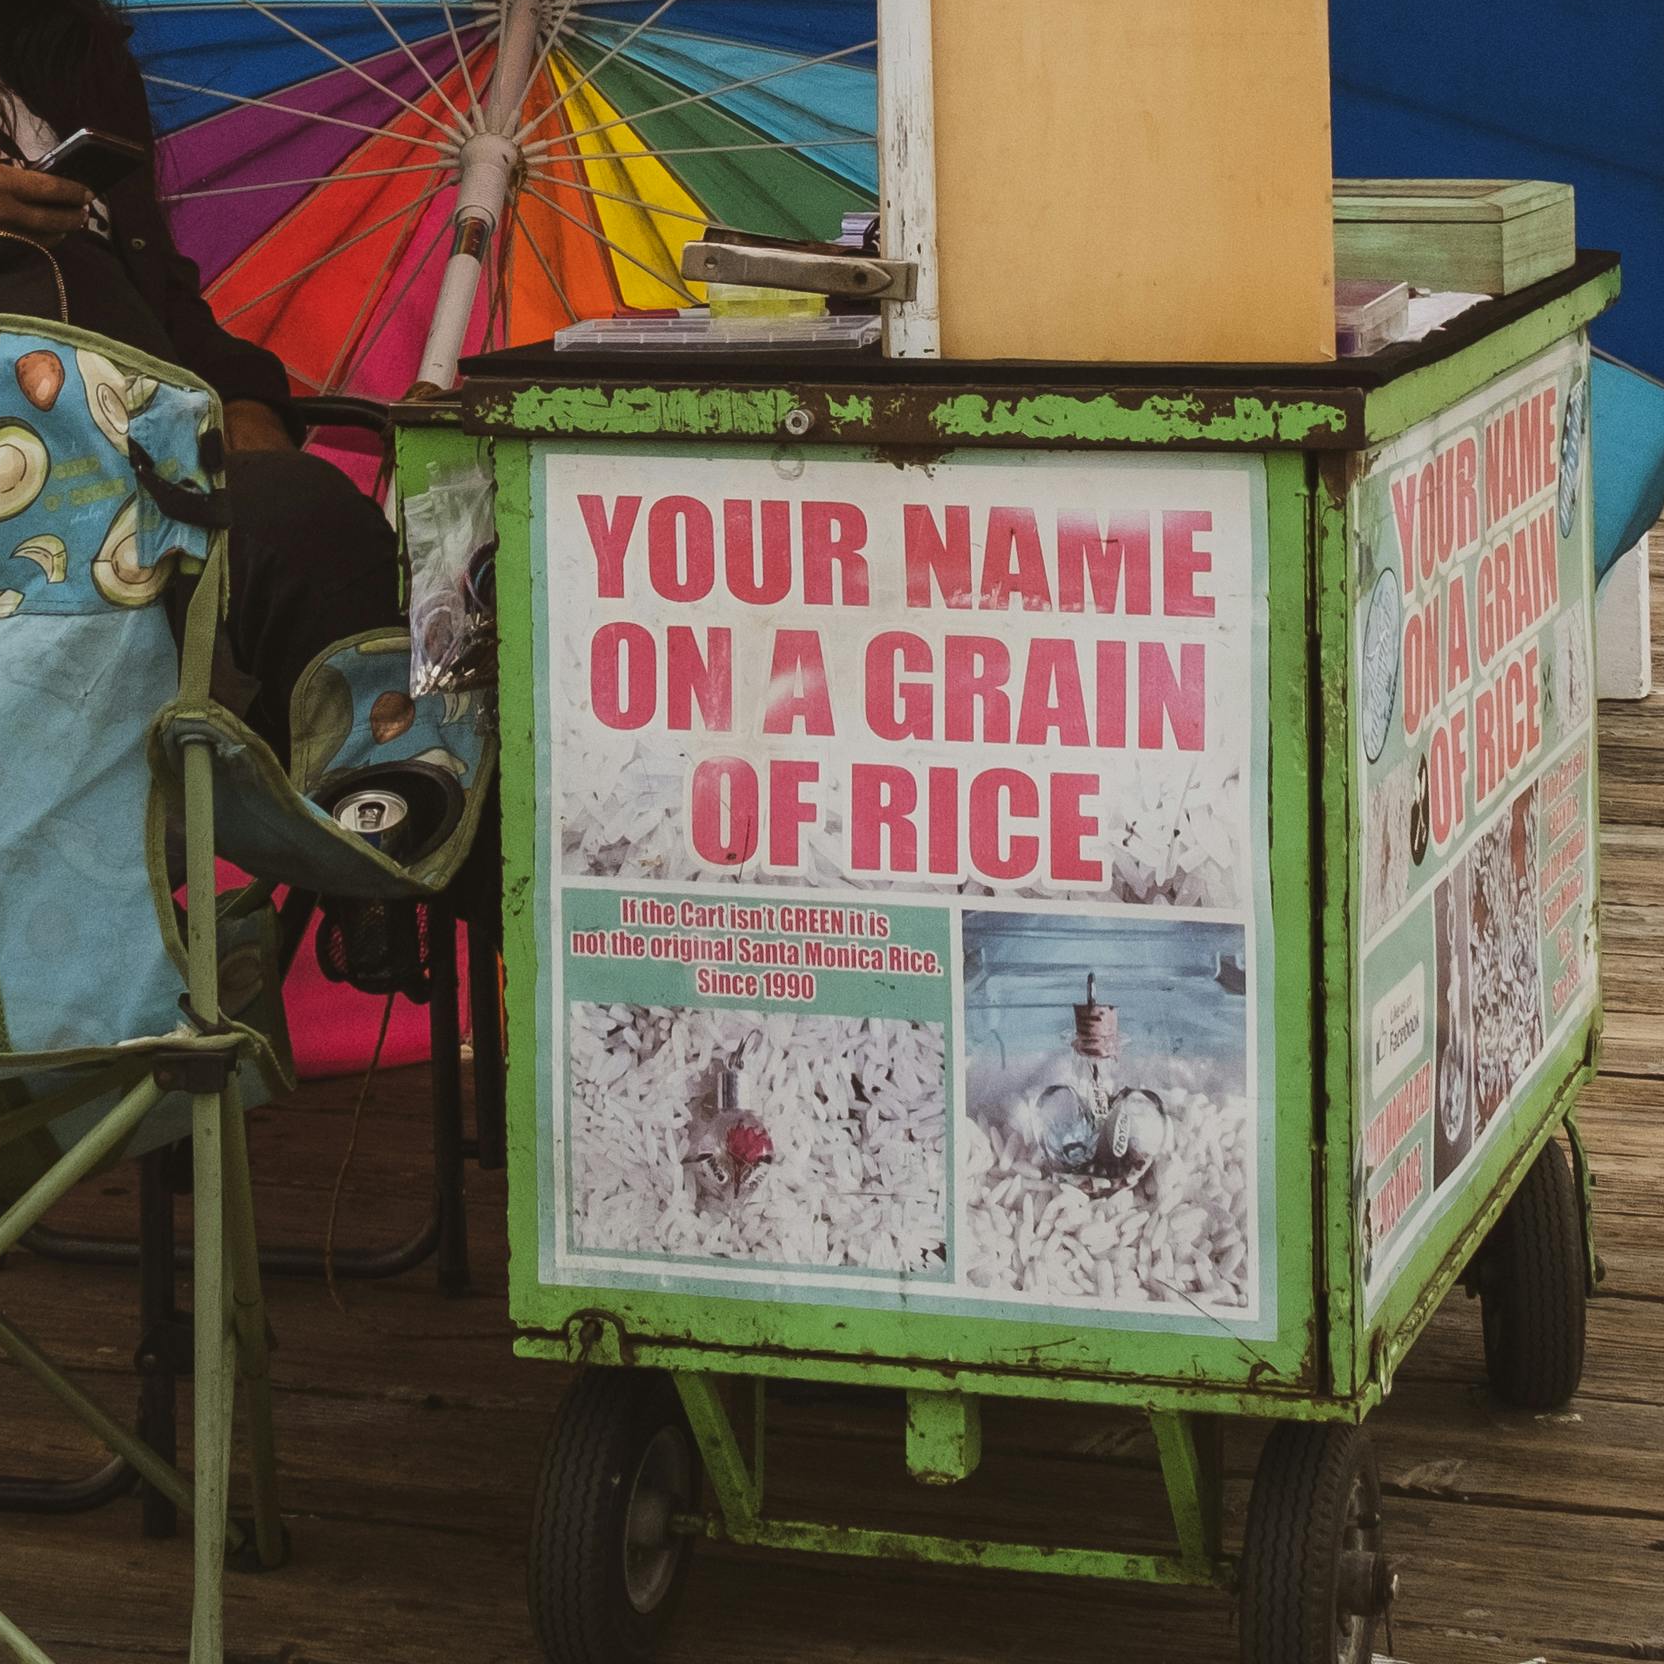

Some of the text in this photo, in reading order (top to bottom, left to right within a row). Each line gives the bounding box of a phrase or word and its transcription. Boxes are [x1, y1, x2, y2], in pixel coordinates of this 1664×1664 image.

[1392, 387, 1556, 594] YOUR NAME
[577, 494, 1216, 617] YOUR NAME
[1404, 506, 1558, 734] ON A GRAIN
[590, 621, 1206, 751] ON A GRAIN
[1430, 647, 1540, 845] OF RICE
[692, 758, 1104, 882] OF RICE
[573, 931, 942, 974] not the original Santa Monica Rice.
[622, 898, 888, 937] If the Cart isn't GREEN it is
[697, 968, 815, 1000] Since 1990
